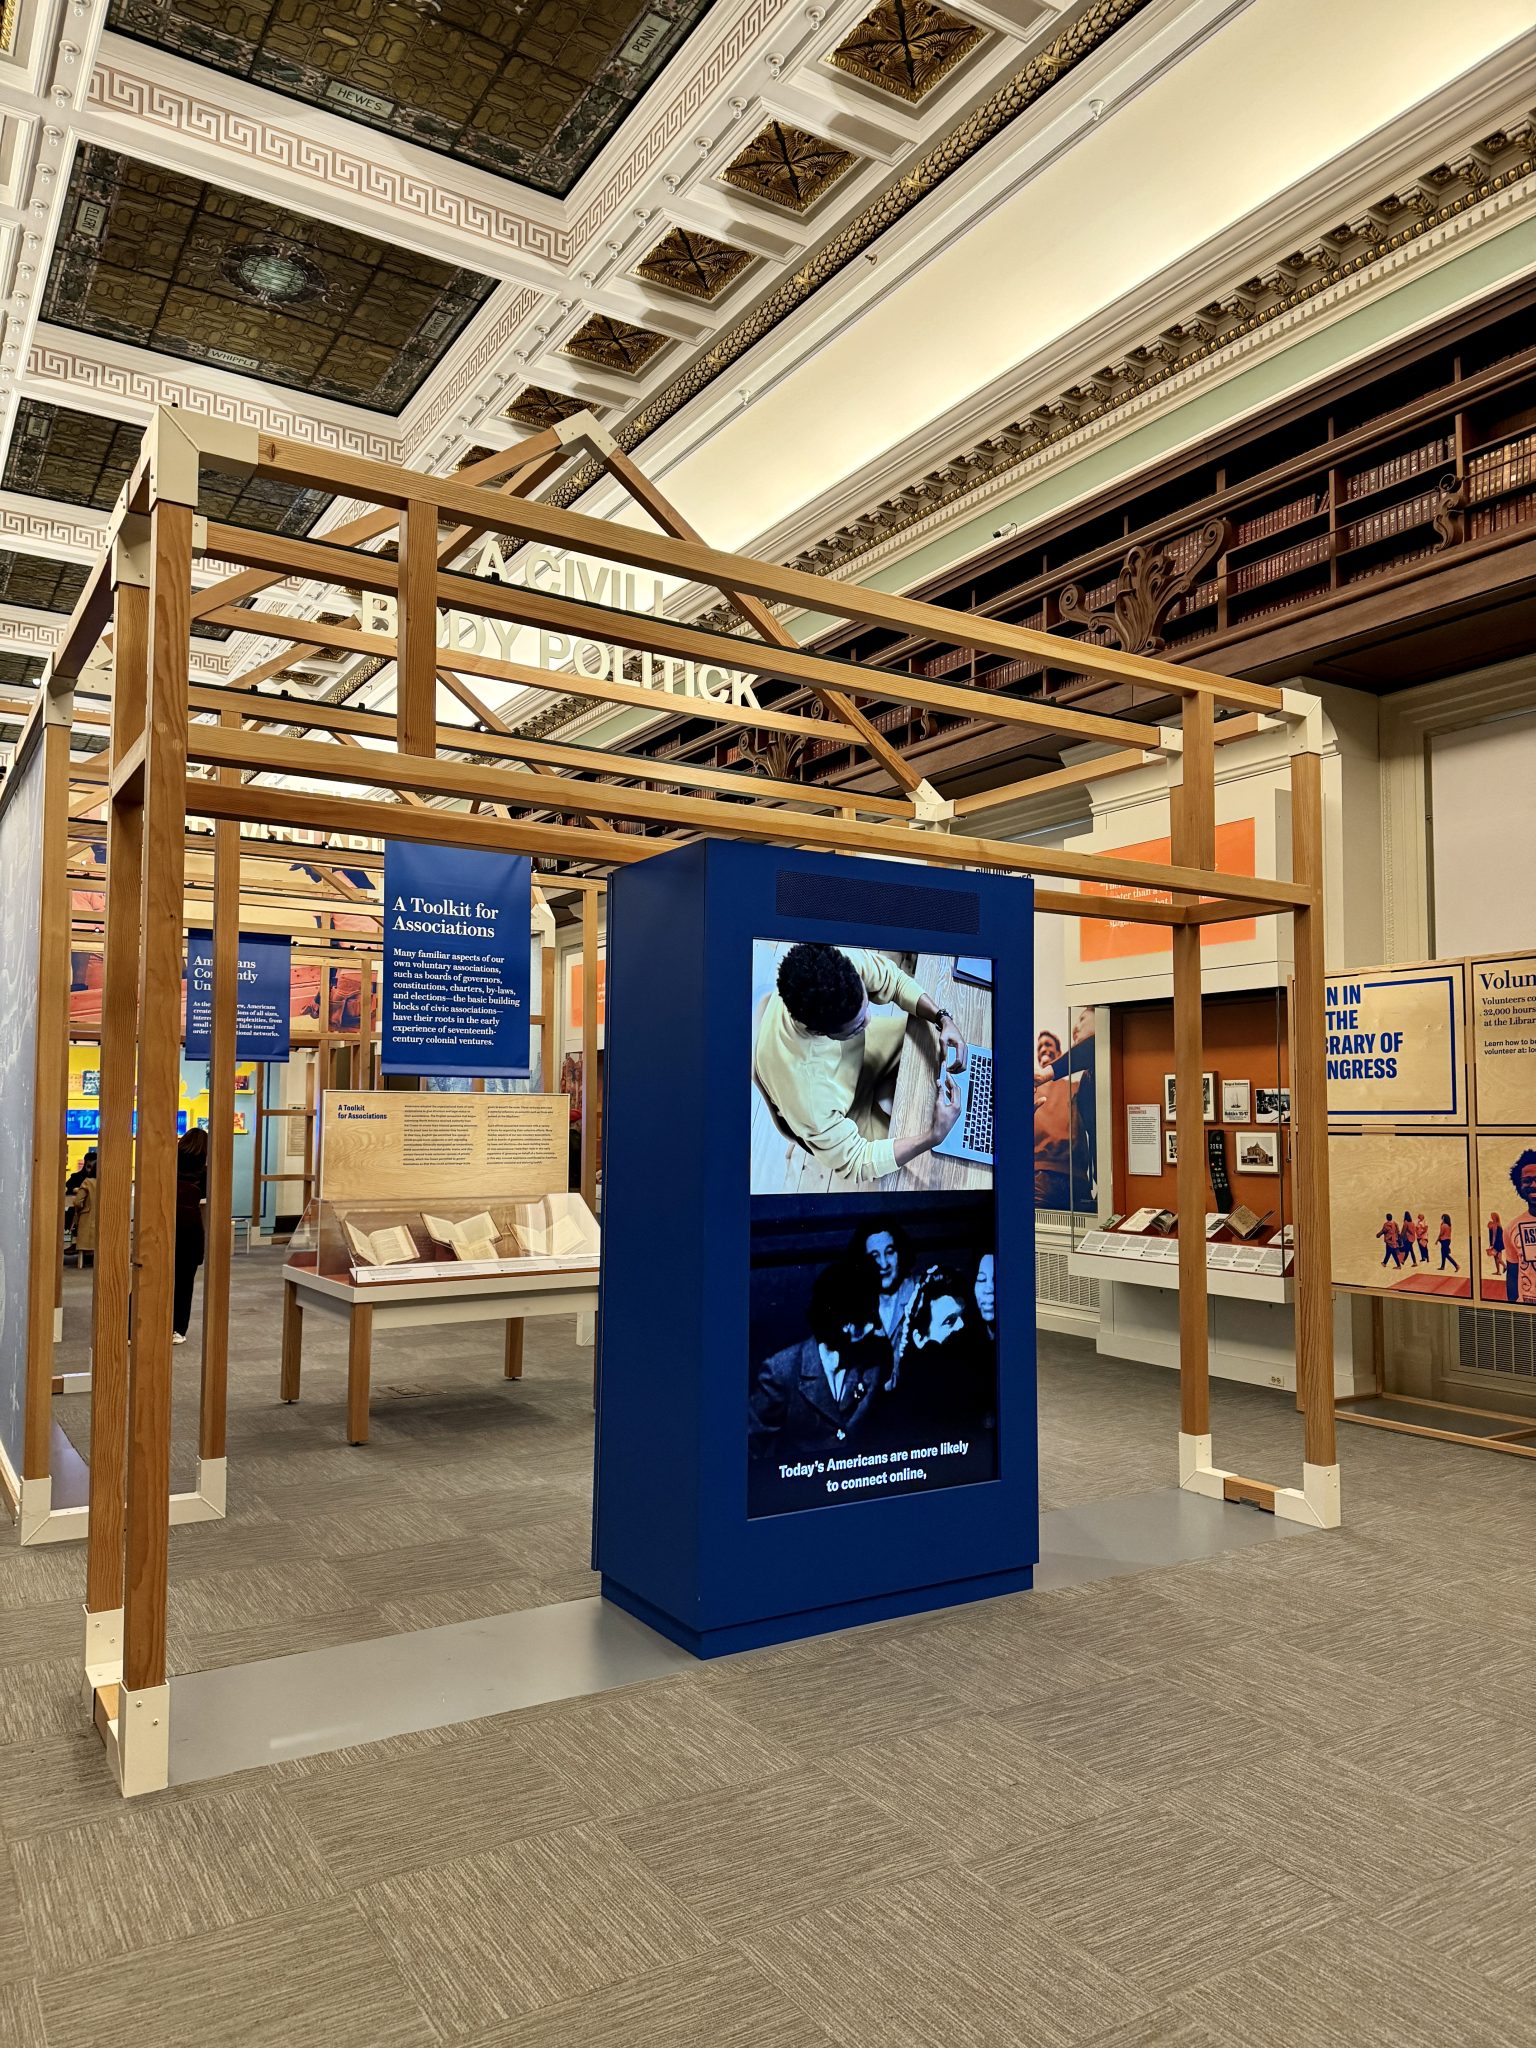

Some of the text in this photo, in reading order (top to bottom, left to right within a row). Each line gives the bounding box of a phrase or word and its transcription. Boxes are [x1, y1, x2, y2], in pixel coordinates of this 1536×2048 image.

[632, 25, 659, 53] PENN
[337, 87, 382, 111] HEWES
[82, 206, 100, 231] ELLERY
[211, 350, 257, 367] WHIPPLE
[475, 540, 508, 580] A
[361, 590, 762, 710] BDY POLITICK
[392, 896, 499, 919] A Toolkit for
[392, 915, 495, 938] Associations
[192, 955, 256, 969] Amans
[393, 948, 416, 959] Many
[418, 950, 450, 960] familiar
[451, 953, 480, 962] aspects
[482, 954, 491, 963] of
[194, 967, 259, 983] Contly
[412, 960, 451, 972] voluntary
[453, 964, 501, 974] associations,
[393, 970, 412, 978] such
[424, 971, 451, 980] boards
[463, 975, 502, 984] governors,
[1479, 969, 1536, 990] Volun
[393, 981, 516, 996] constitutions, charters, by-laws,
[1343, 984, 1361, 1005] IN
[393, 991, 408, 1000] and
[467, 995, 487, 1003] basic
[488, 996, 520, 1007] building
[393, 1002, 419, 1011] blocks
[420, 1003, 430, 1011] of
[430, 1004, 449, 1012] civic
[1482, 995, 1525, 1005] Volunteers
[393, 1013, 412, 1021] have
[413, 1013, 433, 1022] their
[466, 1016, 479, 1024] the
[480, 1017, 500, 1027] early
[1325, 1010, 1358, 1030] THE
[1483, 1007, 1511, 1016] 32,000
[392, 1025, 496, 1035] experience of seventeenth-
[1494, 1018, 1508, 1026] the
[1509, 1017, 1536, 1025] Librar
[392, 1036, 494, 1046] century colonial ventures.
[1325, 1032, 1403, 1055] RARY OF
[1327, 1058, 1397, 1080] NGRESS
[778, 1440, 969, 1478] Today's Americans are more likely
[826, 1468, 927, 1493] to connect online,
